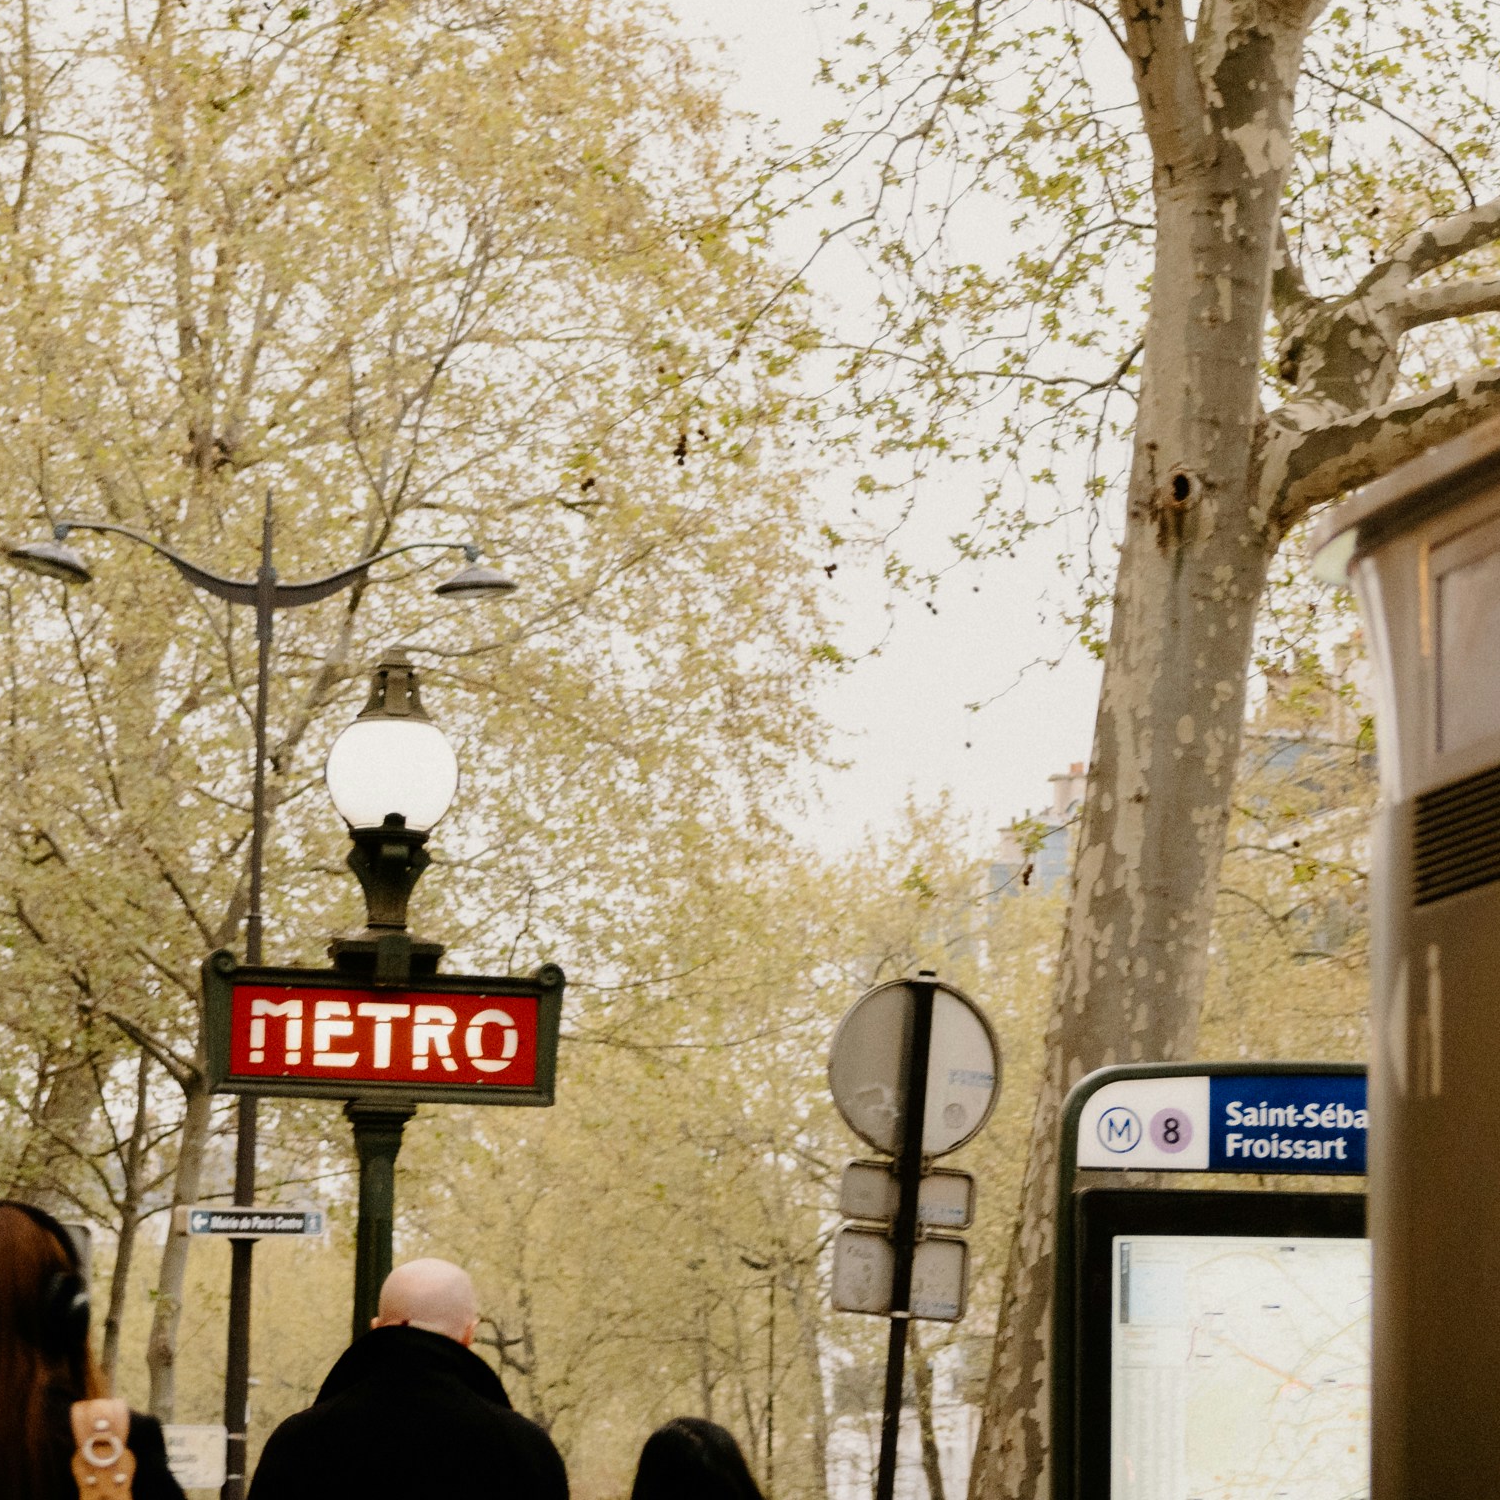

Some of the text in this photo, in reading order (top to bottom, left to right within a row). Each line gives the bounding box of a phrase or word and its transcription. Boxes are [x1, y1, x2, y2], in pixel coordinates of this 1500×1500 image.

[249, 999, 518, 1073] METRO
[1163, 1117, 1180, 1145] 8
[1225, 1133, 1347, 1159] Froissart
